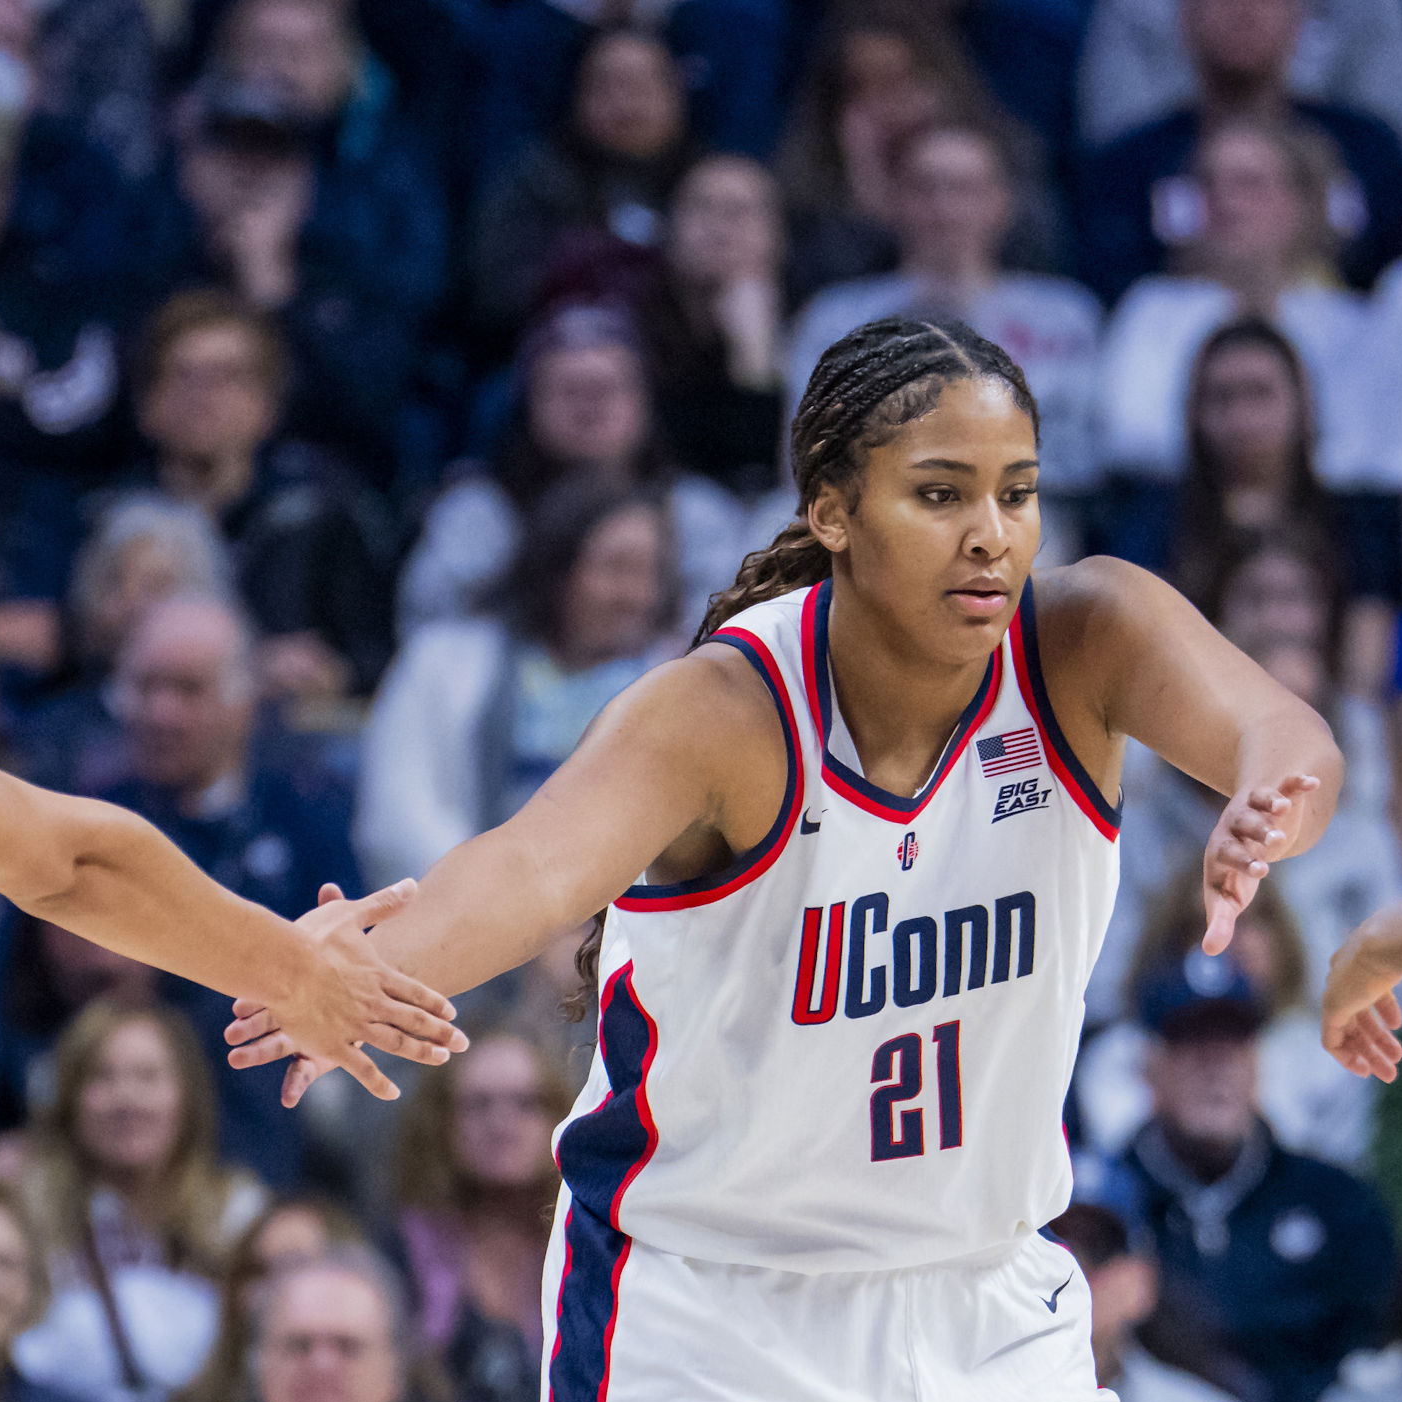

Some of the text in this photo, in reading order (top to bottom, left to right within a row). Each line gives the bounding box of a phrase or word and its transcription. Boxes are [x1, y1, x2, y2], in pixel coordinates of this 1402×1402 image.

[994, 789, 1052, 815] EAST
[998, 778, 1039, 801] BIG
[791, 891, 1036, 1026] UConn
[870, 1019, 962, 1162] 21
